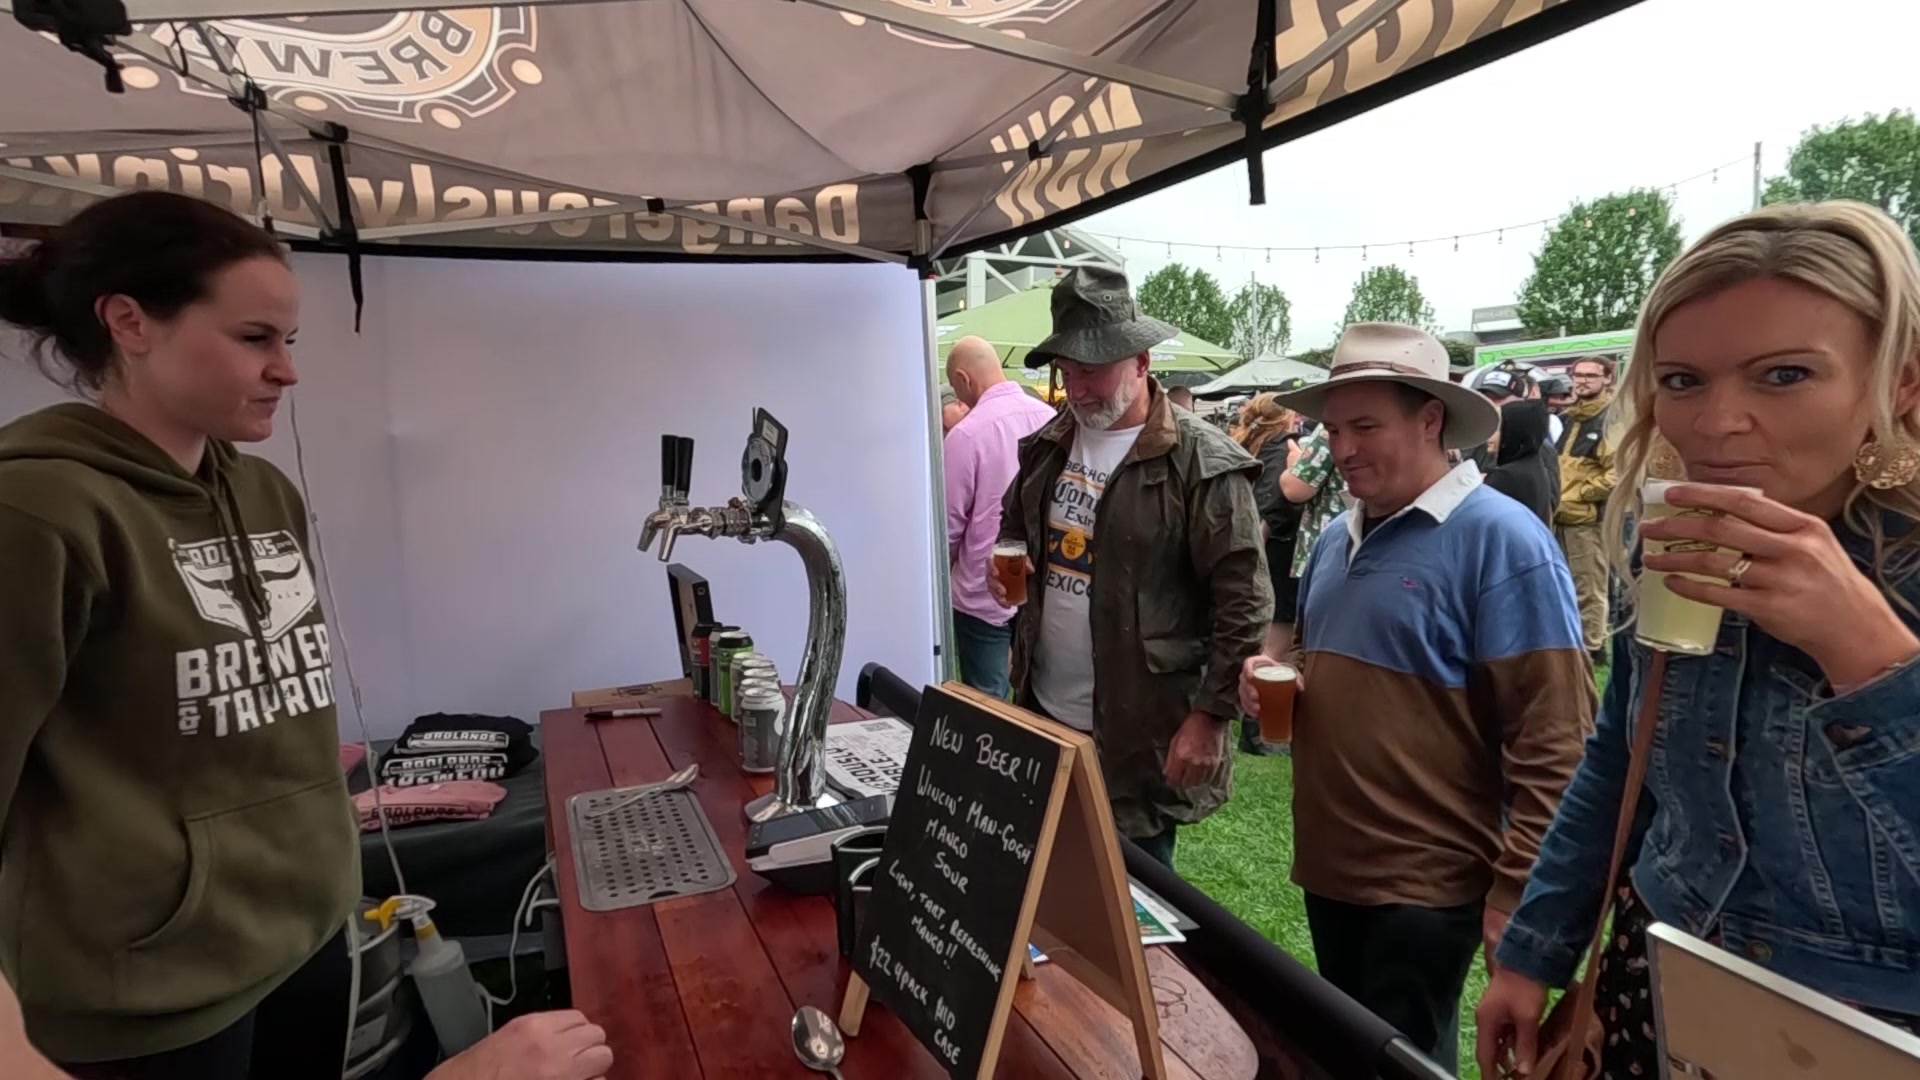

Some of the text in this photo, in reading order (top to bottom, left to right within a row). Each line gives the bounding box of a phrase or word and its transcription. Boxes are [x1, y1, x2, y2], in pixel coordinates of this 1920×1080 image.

[930, 715, 964, 754] NEW
[925, 819, 969, 859] MANGO
[934, 851, 968, 894] SOUR
[869, 935, 892, 976] $22
[920, 892, 946, 931] TART,
[949, 919, 1002, 984] REFRESHING
[934, 1028, 961, 1065] CASE
